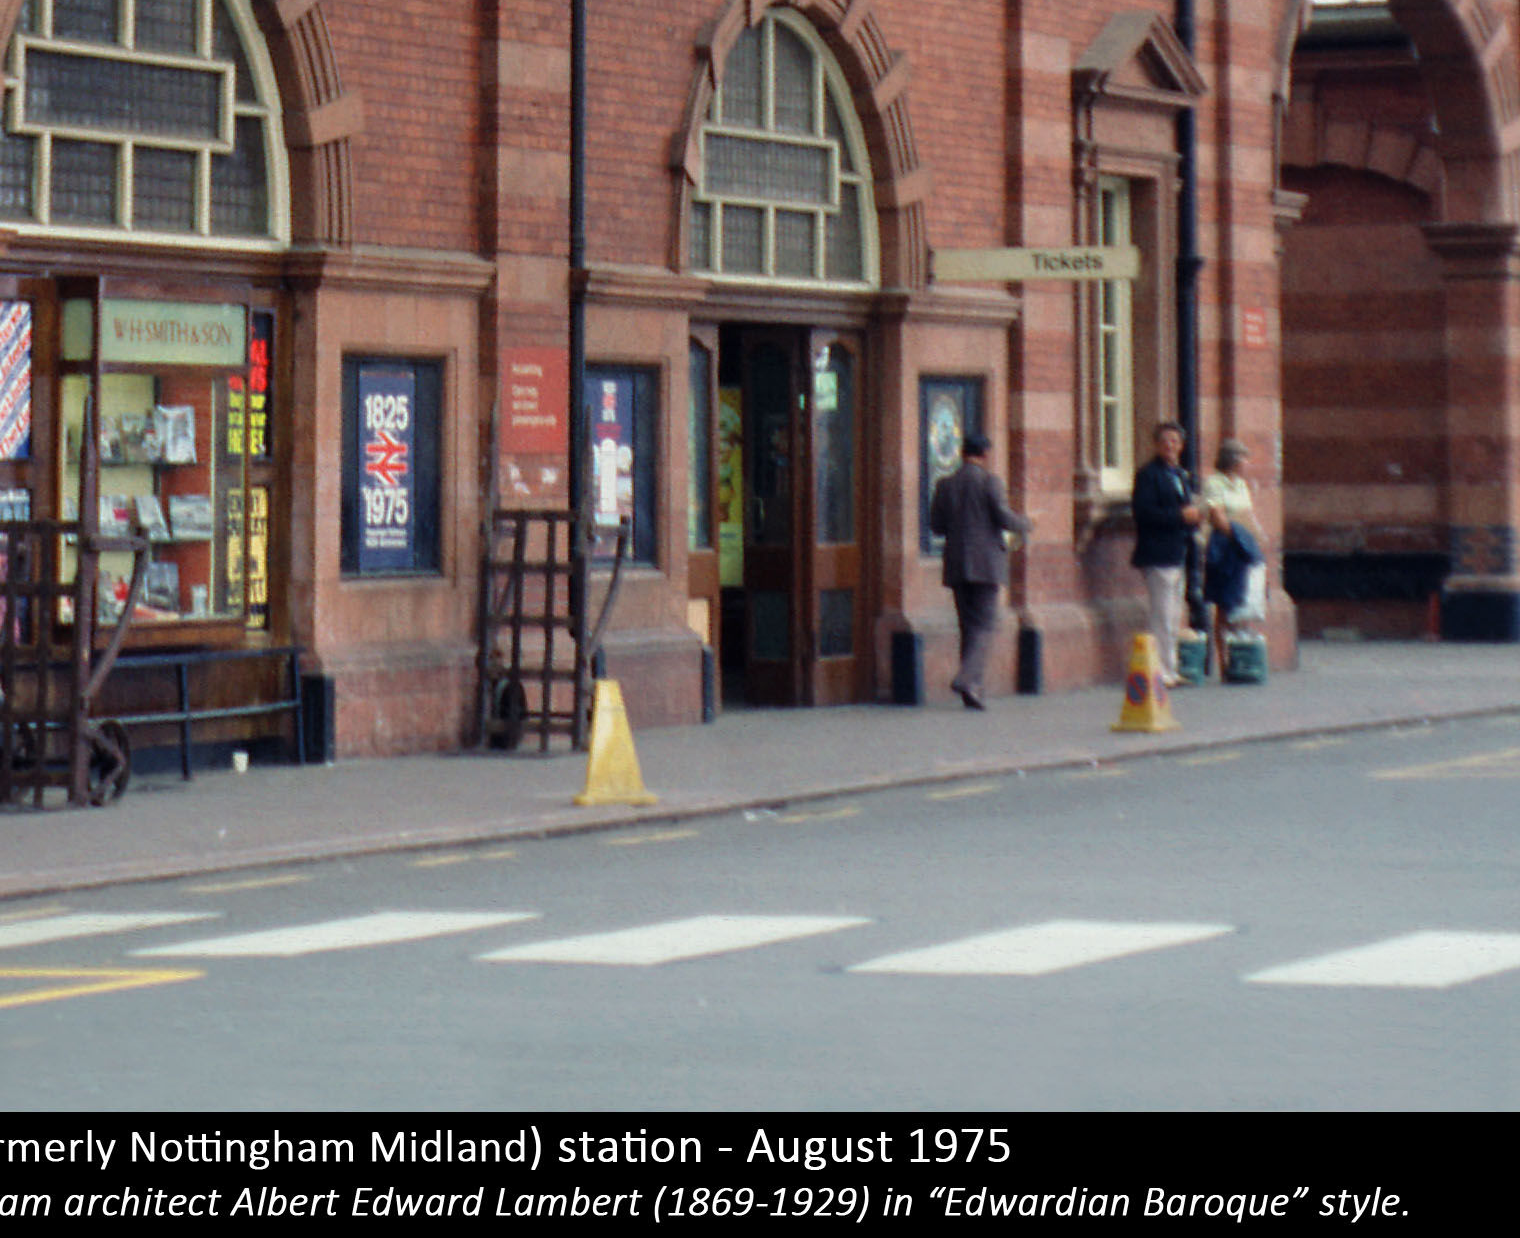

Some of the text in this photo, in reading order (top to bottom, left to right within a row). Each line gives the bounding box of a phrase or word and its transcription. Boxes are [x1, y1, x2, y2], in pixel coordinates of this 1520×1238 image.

[1031, 250, 1104, 272] Tickets
[364, 394, 409, 431] 1825
[362, 485, 409, 526] 1975
